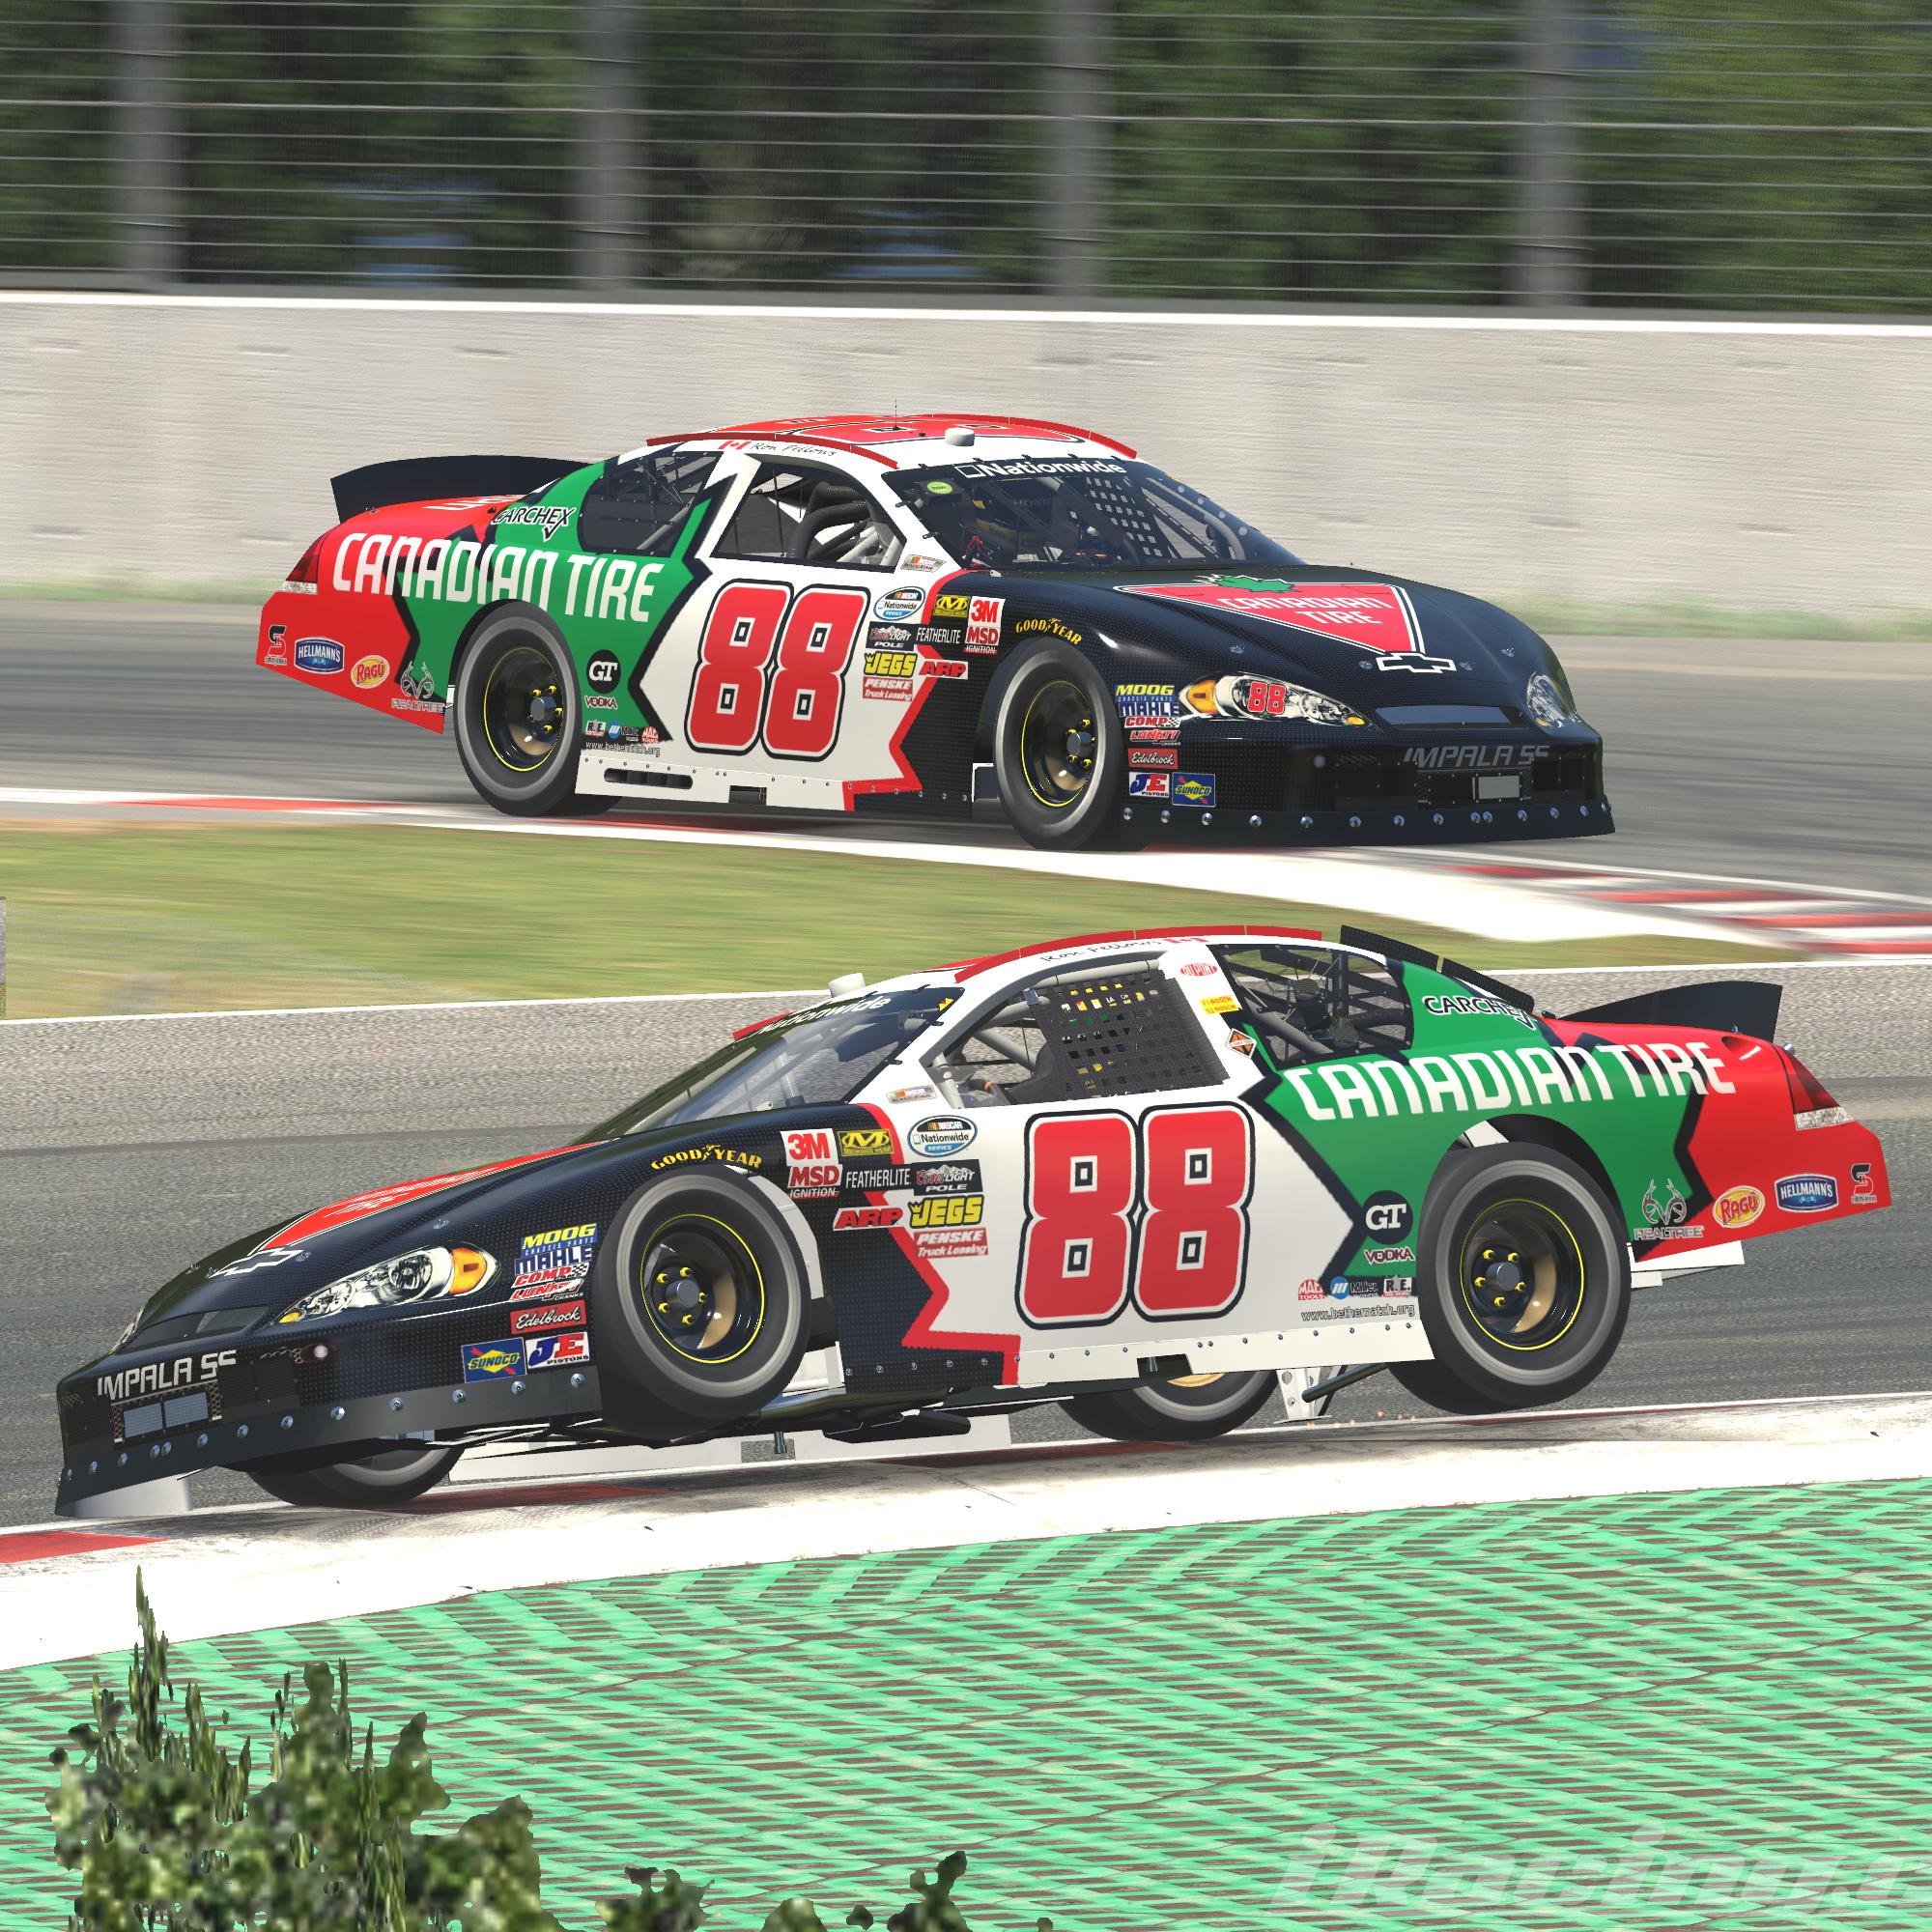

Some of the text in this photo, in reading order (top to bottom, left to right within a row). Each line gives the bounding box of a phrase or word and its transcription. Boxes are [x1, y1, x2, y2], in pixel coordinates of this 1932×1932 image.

[976, 461, 1127, 477] Nationwide
[491, 505, 577, 534] CARCHEX
[332, 532, 666, 623] CANADIAN TIRE
[884, 601, 918, 611] Nationwide
[971, 600, 1000, 624] 3M
[1216, 597, 1396, 611] CANADIAN
[1294, 611, 1383, 625] TIRE
[874, 640, 905, 649] POLE
[916, 627, 962, 644] FEATHERLITE
[965, 626, 1000, 645] MSD
[298, 644, 341, 664] HELLMANN'S
[966, 644, 998, 654] IGNITION
[588, 661, 618, 682] GT
[684, 578, 871, 762] 88
[864, 650, 919, 678] JEGS
[919, 661, 967, 678] ARP
[865, 678, 913, 690] PENSKE
[865, 689, 885, 698] Truck
[1116, 684, 1176, 696] MOOG
[391, 697, 446, 714] REALTREE
[583, 695, 618, 710] VODKA
[1247, 680, 1287, 715] 88
[1119, 702, 1179, 717] MAHLE
[1125, 717, 1169, 727] COMP
[1131, 752, 1175, 766] Edelbrock
[1404, 745, 1514, 769] IMPALA
[1129, 773, 1168, 794] JE
[1175, 785, 1212, 796] SUNOCO
[1283, 1041, 1737, 1122] CANADIAN TIRE
[787, 1132, 831, 1160] 3M
[921, 1132, 970, 1144] Nationwide
[789, 1165, 840, 1187] MSD
[845, 1168, 911, 1189] FEATHERLITE
[789, 1186, 837, 1198] IGNITION
[925, 1183, 968, 1193] POLE
[1780, 1181, 1833, 1200] HELLMANN'S
[834, 1207, 904, 1229] ARP
[908, 1194, 985, 1229] JEGS
[1014, 1100, 1256, 1330] 88
[1365, 1204, 1407, 1231] GT
[522, 1223, 597, 1250] MOOG
[916, 1229, 984, 1246] PENSKE
[1633, 1224, 1705, 1241] REALTREE
[514, 1245, 592, 1276] MAHLE
[918, 1244, 987, 1258] Truck Leasing
[1363, 1246, 1416, 1265] VODKA
[514, 1265, 573, 1287] COMP
[515, 1306, 582, 1330] Edelbrock
[1300, 1303, 1416, 1321] www.bethematch.org
[527, 1333, 585, 1367] JE
[547, 1354, 589, 1365] PISTONS
[468, 1351, 523, 1370] SUNOCO
[98, 1357, 193, 1401] IMPALA
